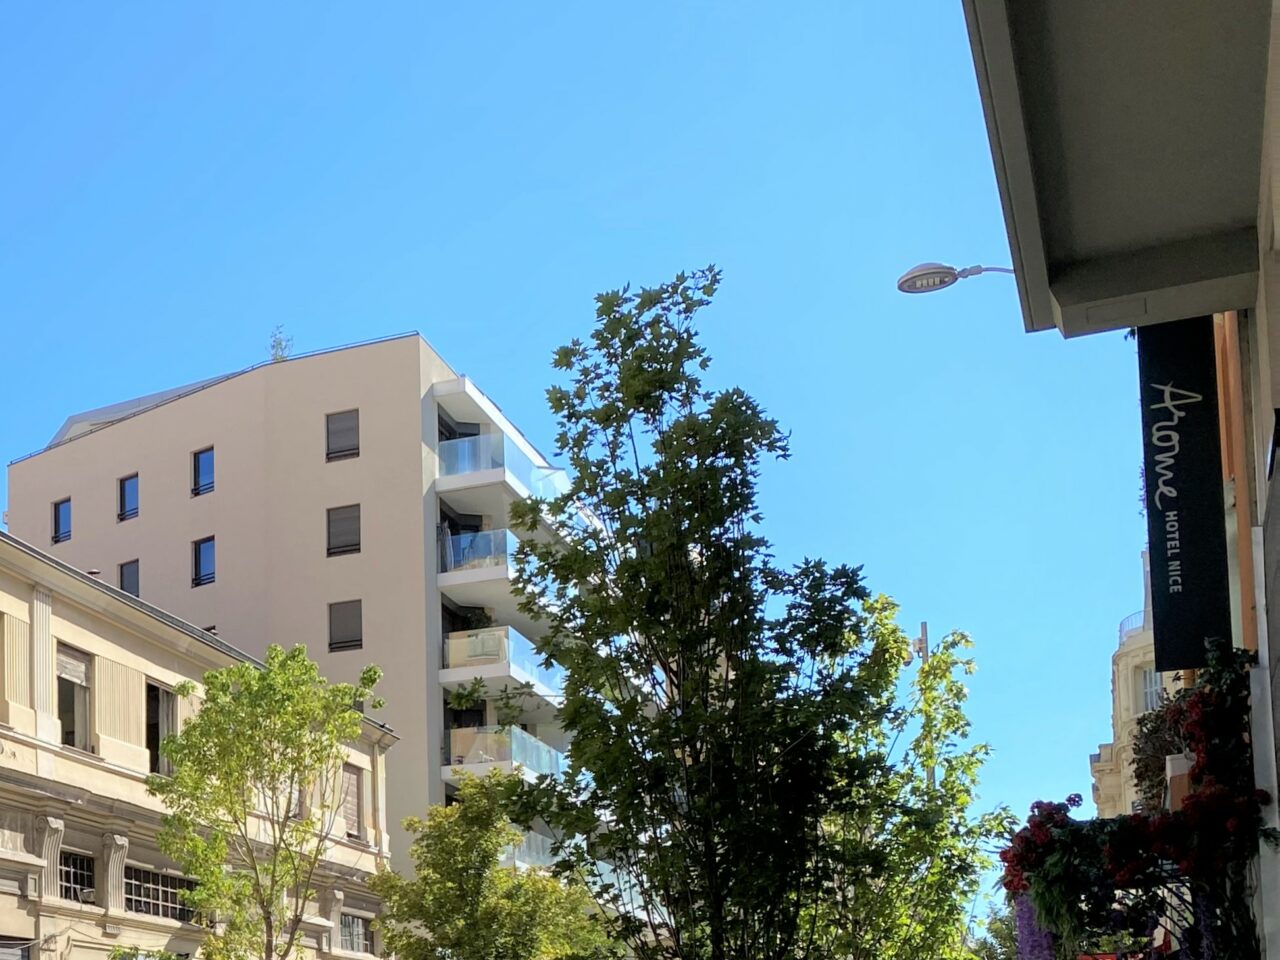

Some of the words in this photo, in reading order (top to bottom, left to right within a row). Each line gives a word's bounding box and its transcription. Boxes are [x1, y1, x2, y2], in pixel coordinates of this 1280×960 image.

[1150, 381, 1203, 511] Arome
[1165, 511, 1180, 557] HOTEL
[1168, 560, 1182, 593] NICE
